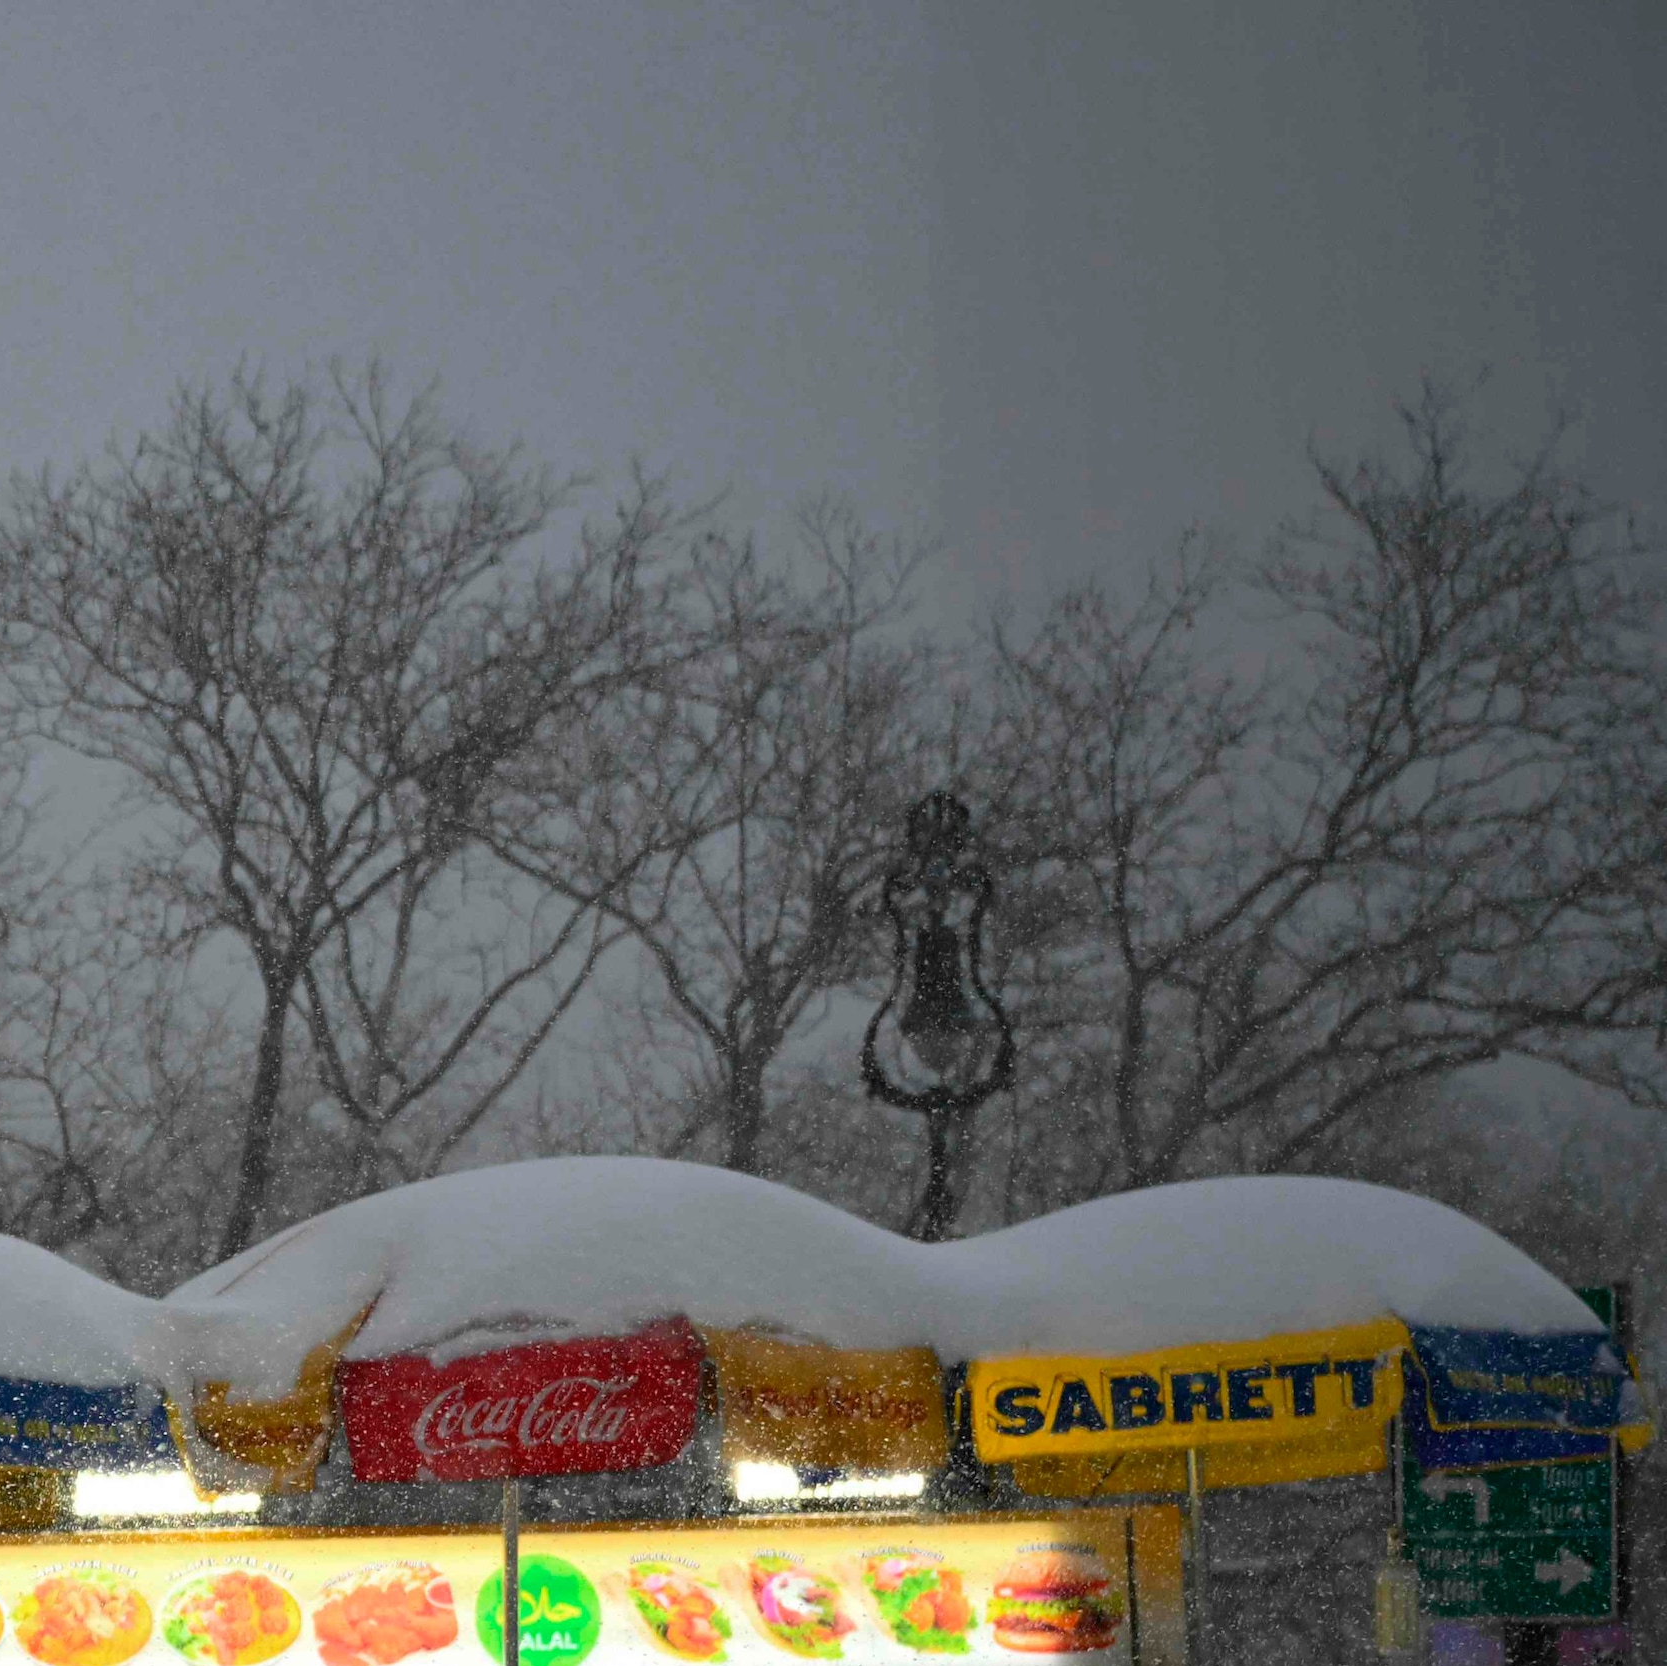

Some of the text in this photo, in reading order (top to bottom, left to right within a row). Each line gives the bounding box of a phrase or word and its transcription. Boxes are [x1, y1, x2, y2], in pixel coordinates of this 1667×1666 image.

[413, 1375, 639, 1455] Coca-Cola
[995, 1358, 1379, 1437] SABRETT
[520, 1632, 578, 1650] ALAL
